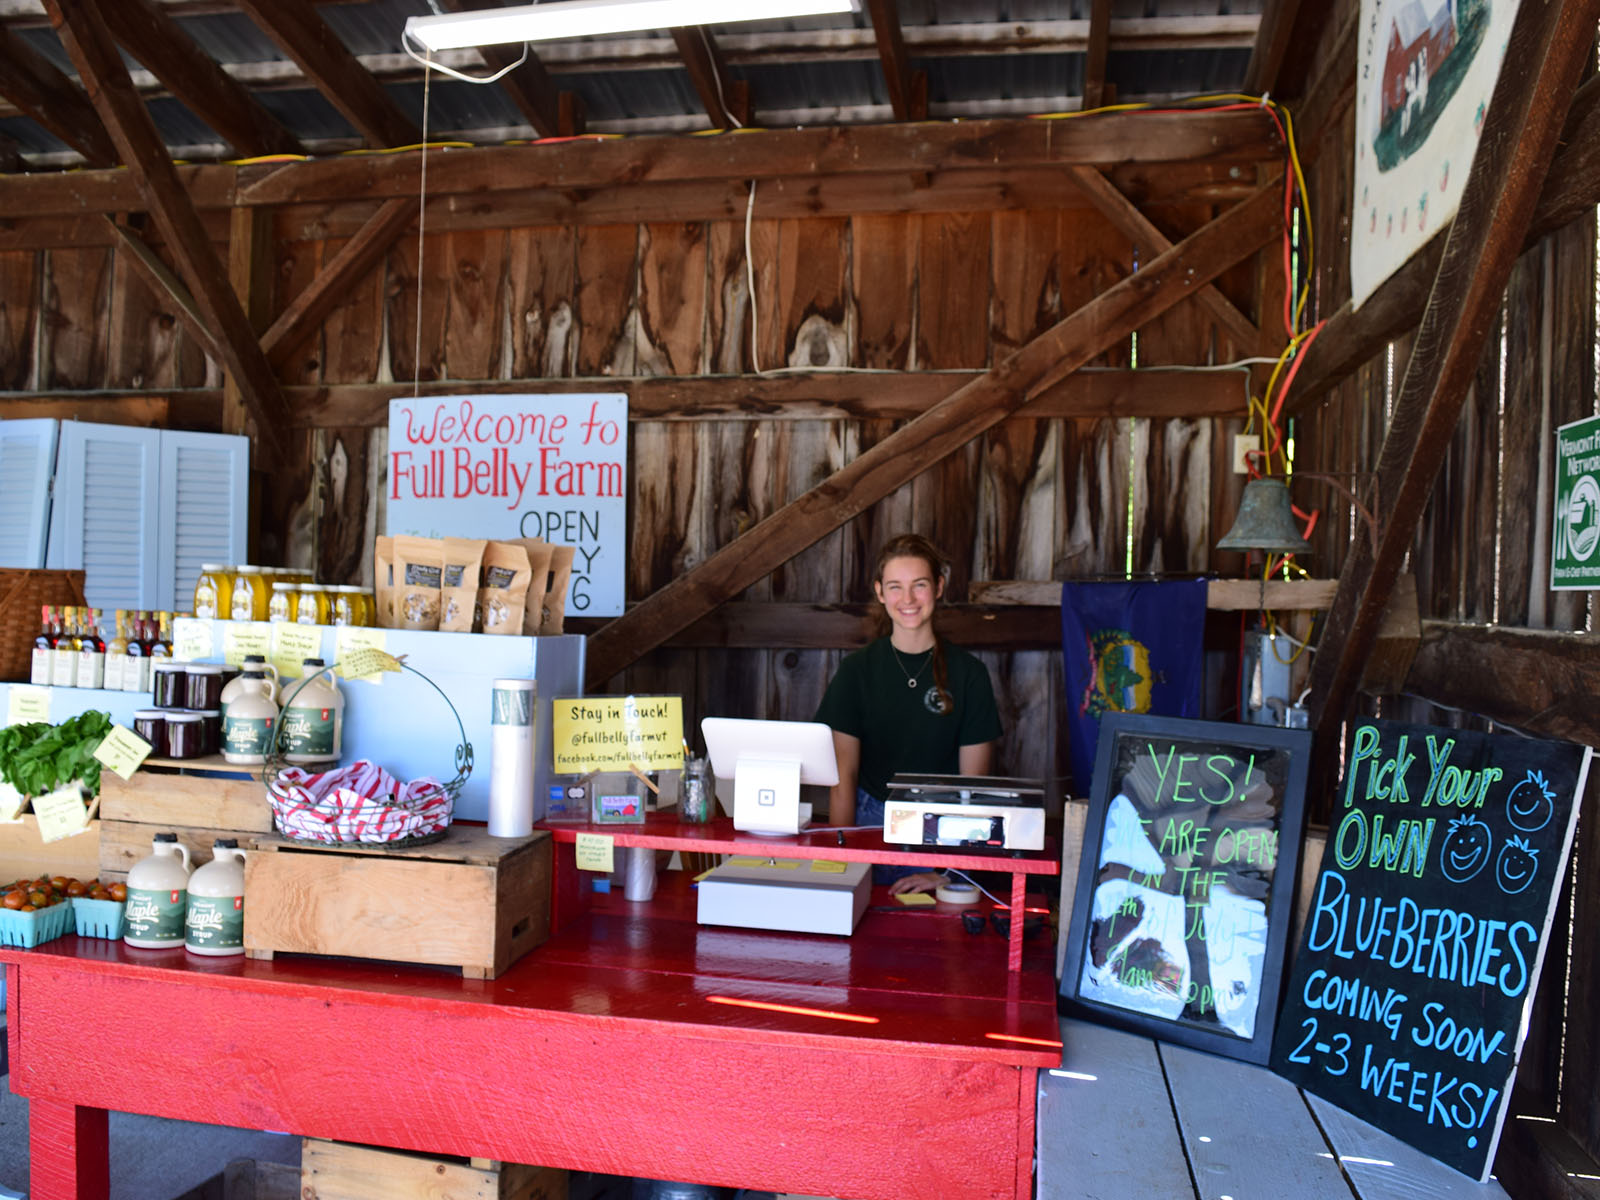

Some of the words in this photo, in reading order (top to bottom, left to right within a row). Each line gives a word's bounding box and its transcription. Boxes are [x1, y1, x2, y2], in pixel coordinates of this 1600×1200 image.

[401, 401, 568, 445] Welcome
[580, 401, 620, 446] to
[390, 451, 445, 500] Full
[453, 447, 533, 511] Belly
[537, 447, 624, 498] Farm
[520, 511, 600, 543] OPEN
[571, 706, 602, 723] Stay
[607, 701, 620, 719] in
[624, 702, 668, 718] Touch!
[1148, 744, 1256, 805] YES!
[1343, 725, 1417, 808] Pick
[1420, 734, 1504, 810] Your
[1159, 818, 1212, 864] ARE
[1214, 828, 1279, 866] OPEN
[1334, 808, 1437, 879] OWN
[1174, 866, 1229, 901] THE
[1308, 870, 1538, 998] BLUEBERRIES
[1303, 969, 1408, 1041] COMING
[1289, 1017, 1353, 1076] 2-3
[1360, 1043, 1499, 1150] WEEKS!
